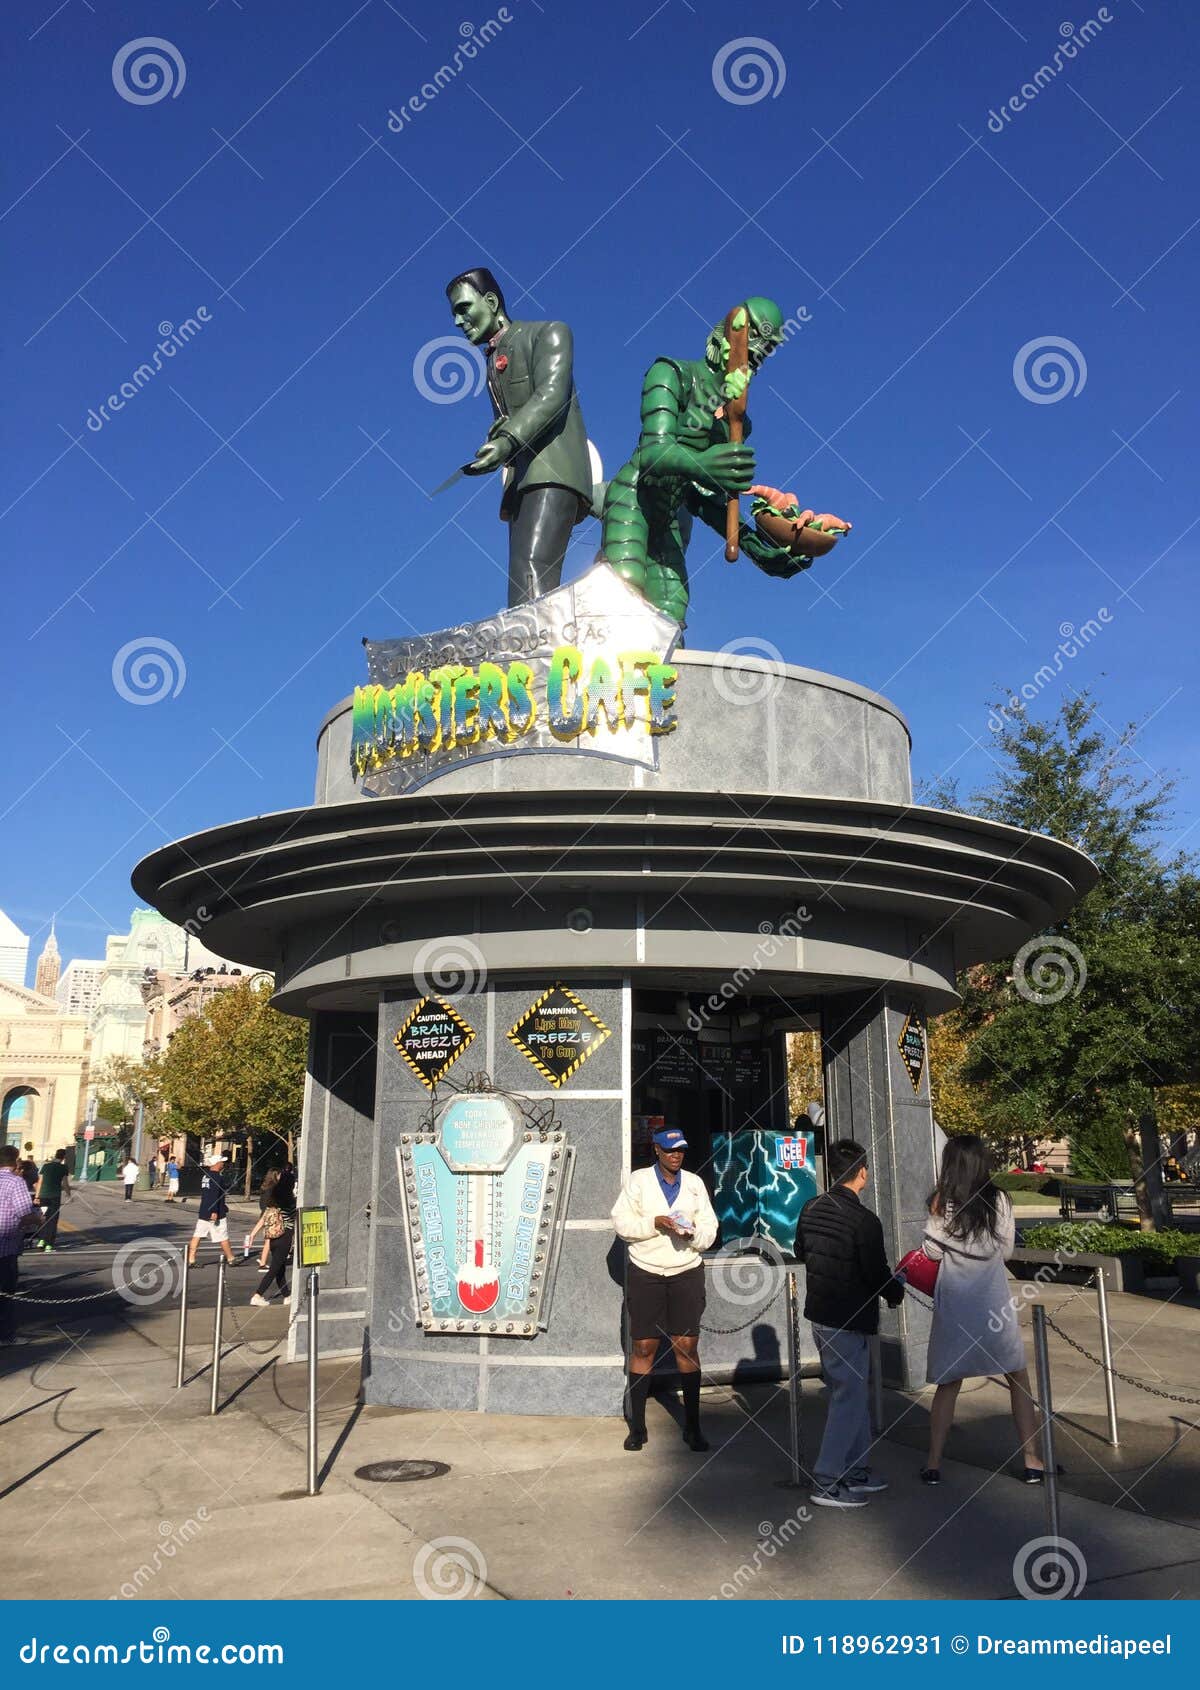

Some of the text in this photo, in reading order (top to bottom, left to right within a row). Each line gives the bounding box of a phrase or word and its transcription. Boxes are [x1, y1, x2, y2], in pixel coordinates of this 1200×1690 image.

[350, 645, 678, 784] MONSTERS CAFE
[416, 1013, 449, 1023] CAUTION:
[538, 1007, 578, 1016] WARNING
[410, 1023, 455, 1036] BRAIN
[534, 1017, 581, 1033] Lips May
[405, 1035, 461, 1050] FREEZE
[527, 1032, 592, 1045] FREEZE
[415, 1050, 447, 1060] AHEAD!
[540, 1045, 576, 1060] To Cup
[779, 1142, 803, 1161] ICEE
[302, 1222, 325, 1234] ENTER
[418, 1162, 450, 1299] EXTREME COLD!
[507, 1161, 545, 1300] EXTREME COLD!
[304, 1235, 324, 1247] HERE
